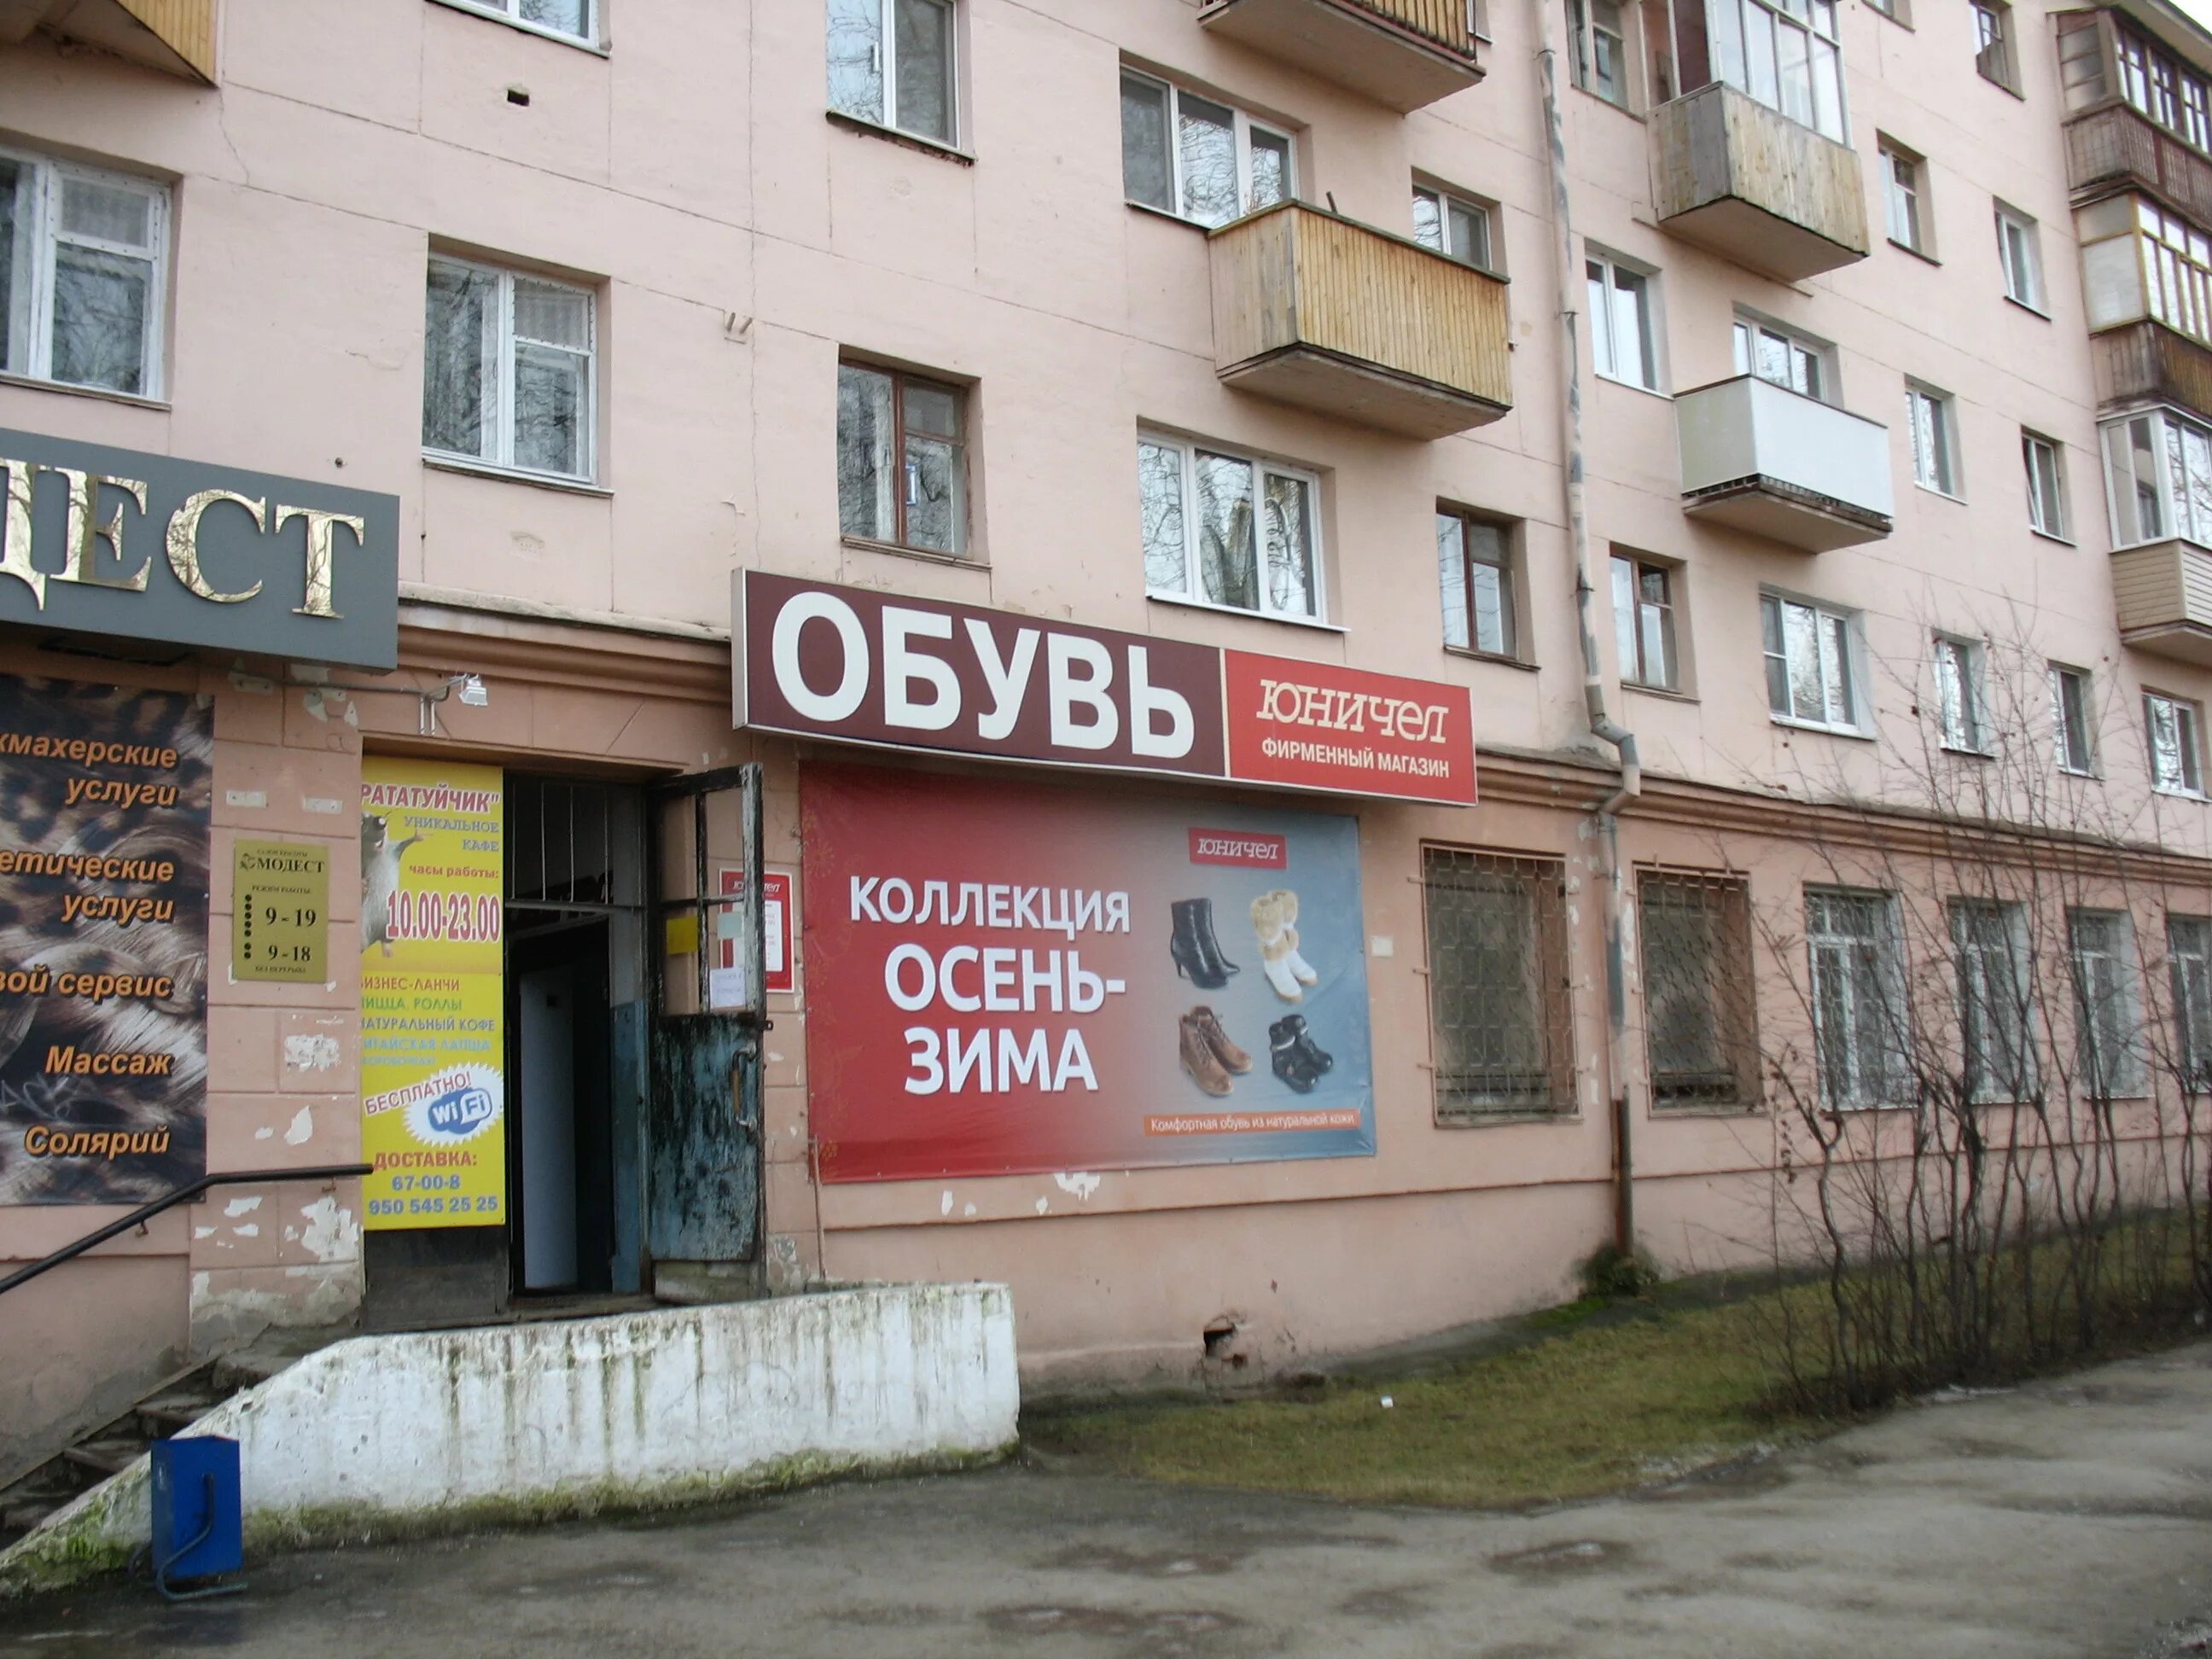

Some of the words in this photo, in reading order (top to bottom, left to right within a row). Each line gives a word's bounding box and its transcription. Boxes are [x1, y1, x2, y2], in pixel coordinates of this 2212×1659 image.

[771, 591, 1195, 759] ОБУВЬ
[1261, 737, 1375, 769] ФИРМЕННЫЙ
[1377, 752, 1449, 778] МАГАЗИН
[64, 777, 178, 809] услуги
[405, 815, 500, 833] УНИКАЛЬНОЕ
[462, 838, 500, 853] КАФЕ
[0, 849, 175, 882] етические
[257, 857, 325, 874] МОДЕСТ
[409, 864, 443, 876] часы
[446, 864, 499, 880] работы:
[61, 894, 174, 926] услуги
[387, 889, 501, 942] 10.00-23.00
[850, 876, 1131, 941] КОЛЛЕКЦИЯ
[58, 972, 172, 1003] сервис
[362, 976, 460, 991] ИЗНЕС-ЛАНЧИ
[884, 943, 1126, 1013] ОСЕНЬ-
[362, 997, 409, 1011] ИЦЦА,
[414, 998, 462, 1011] РОЛЛЫ
[459, 1019, 495, 1031] КОФЕ
[362, 1036, 436, 1051] ИТАЙСКАЯ
[45, 1045, 172, 1074] Массаж
[904, 1027, 1099, 1095] ЗИМА
[364, 1072, 472, 1115] БЕСПЛАТНО!
[1150, 1116, 1219, 1133] Комфортная
[1220, 1114, 1250, 1132] обувь
[1252, 1116, 1264, 1128] из
[25, 1126, 170, 1161] Солярий
[373, 1151, 478, 1172] ДОСТАВКА:
[392, 1173, 461, 1191] 67-00-8
[368, 1198, 405, 1215] 950
[409, 1196, 444, 1214] 545
[449, 1196, 471, 1213] 25
[476, 1195, 498, 1212] 25
